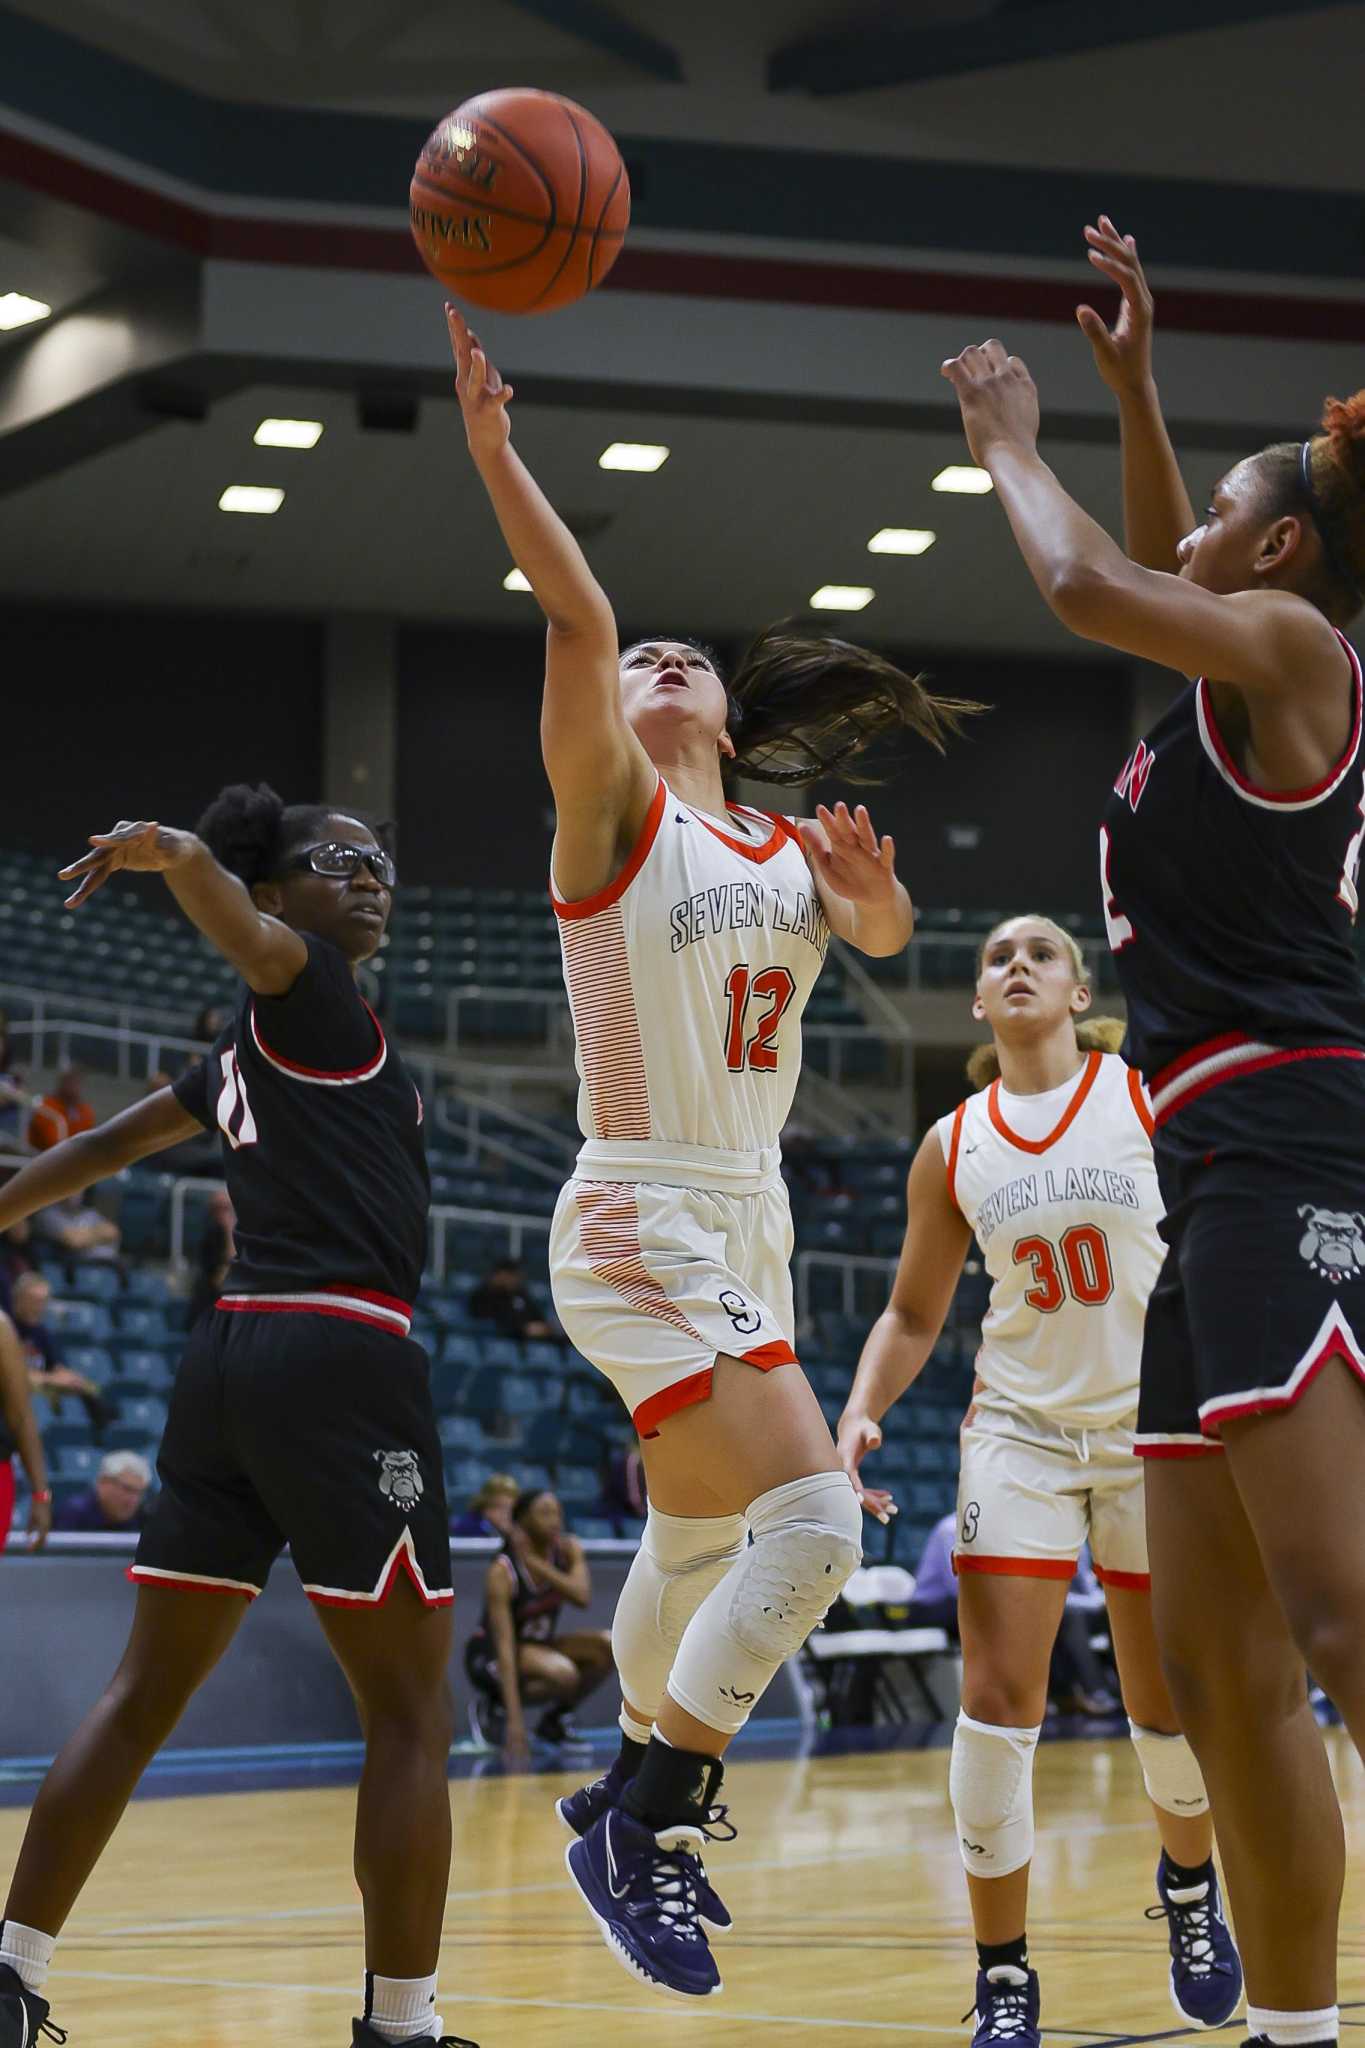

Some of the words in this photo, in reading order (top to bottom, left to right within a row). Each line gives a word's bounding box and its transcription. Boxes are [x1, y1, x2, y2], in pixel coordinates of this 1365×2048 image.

[670, 882, 763, 953] SEVEN
[772, 888, 830, 961] LAK
[724, 963, 796, 1072] 12
[976, 1174, 1039, 1244] SEVEN
[1045, 1167, 1140, 1209] LAKES
[1012, 1223, 1115, 1313] 30
[961, 1501, 980, 1543] S
